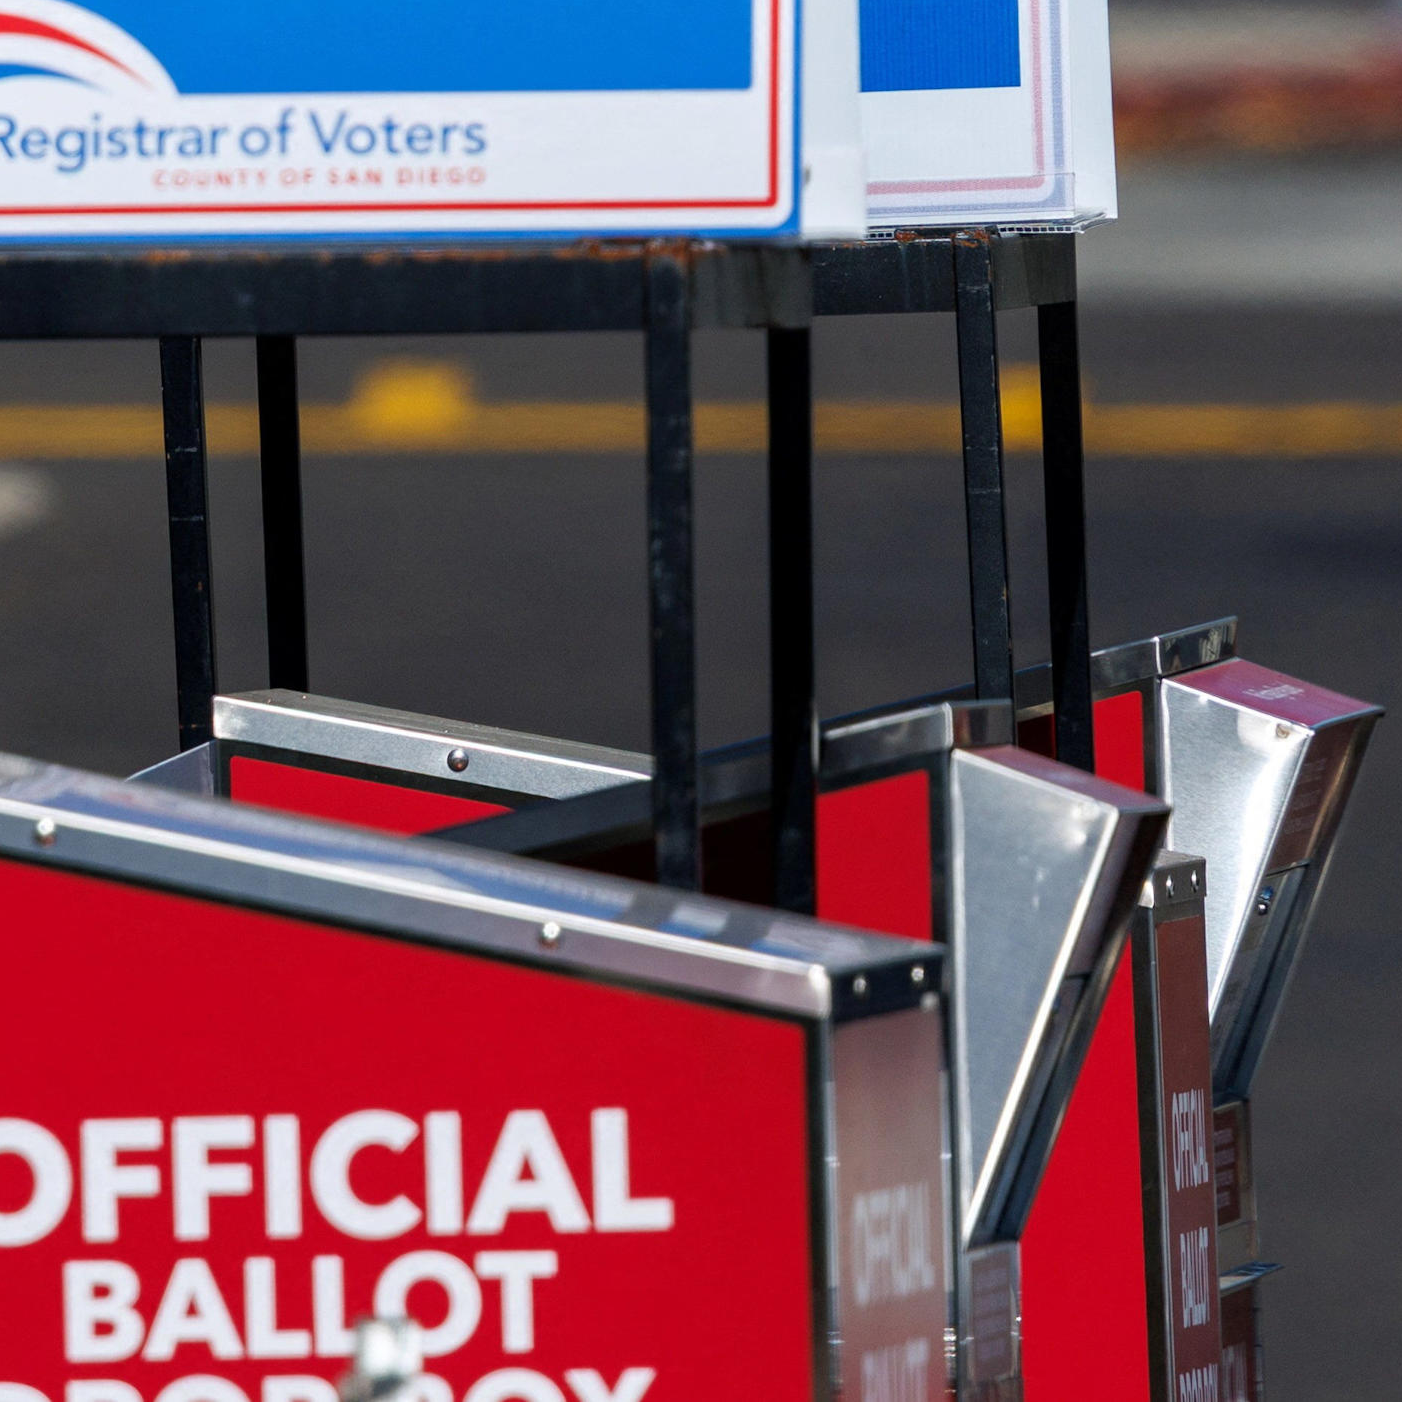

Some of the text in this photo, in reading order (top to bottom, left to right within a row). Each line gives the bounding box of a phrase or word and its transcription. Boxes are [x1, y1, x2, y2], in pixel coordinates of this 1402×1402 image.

[152, 165, 486, 188] COUNTY OF SAN DIEGO
[237, 107, 296, 159] of
[308, 110, 489, 158] Voters
[1172, 1088, 1209, 1192] OFFICIAL
[63, 1249, 559, 1364] BALLOT
[1180, 1227, 1211, 1329] BALLOT
